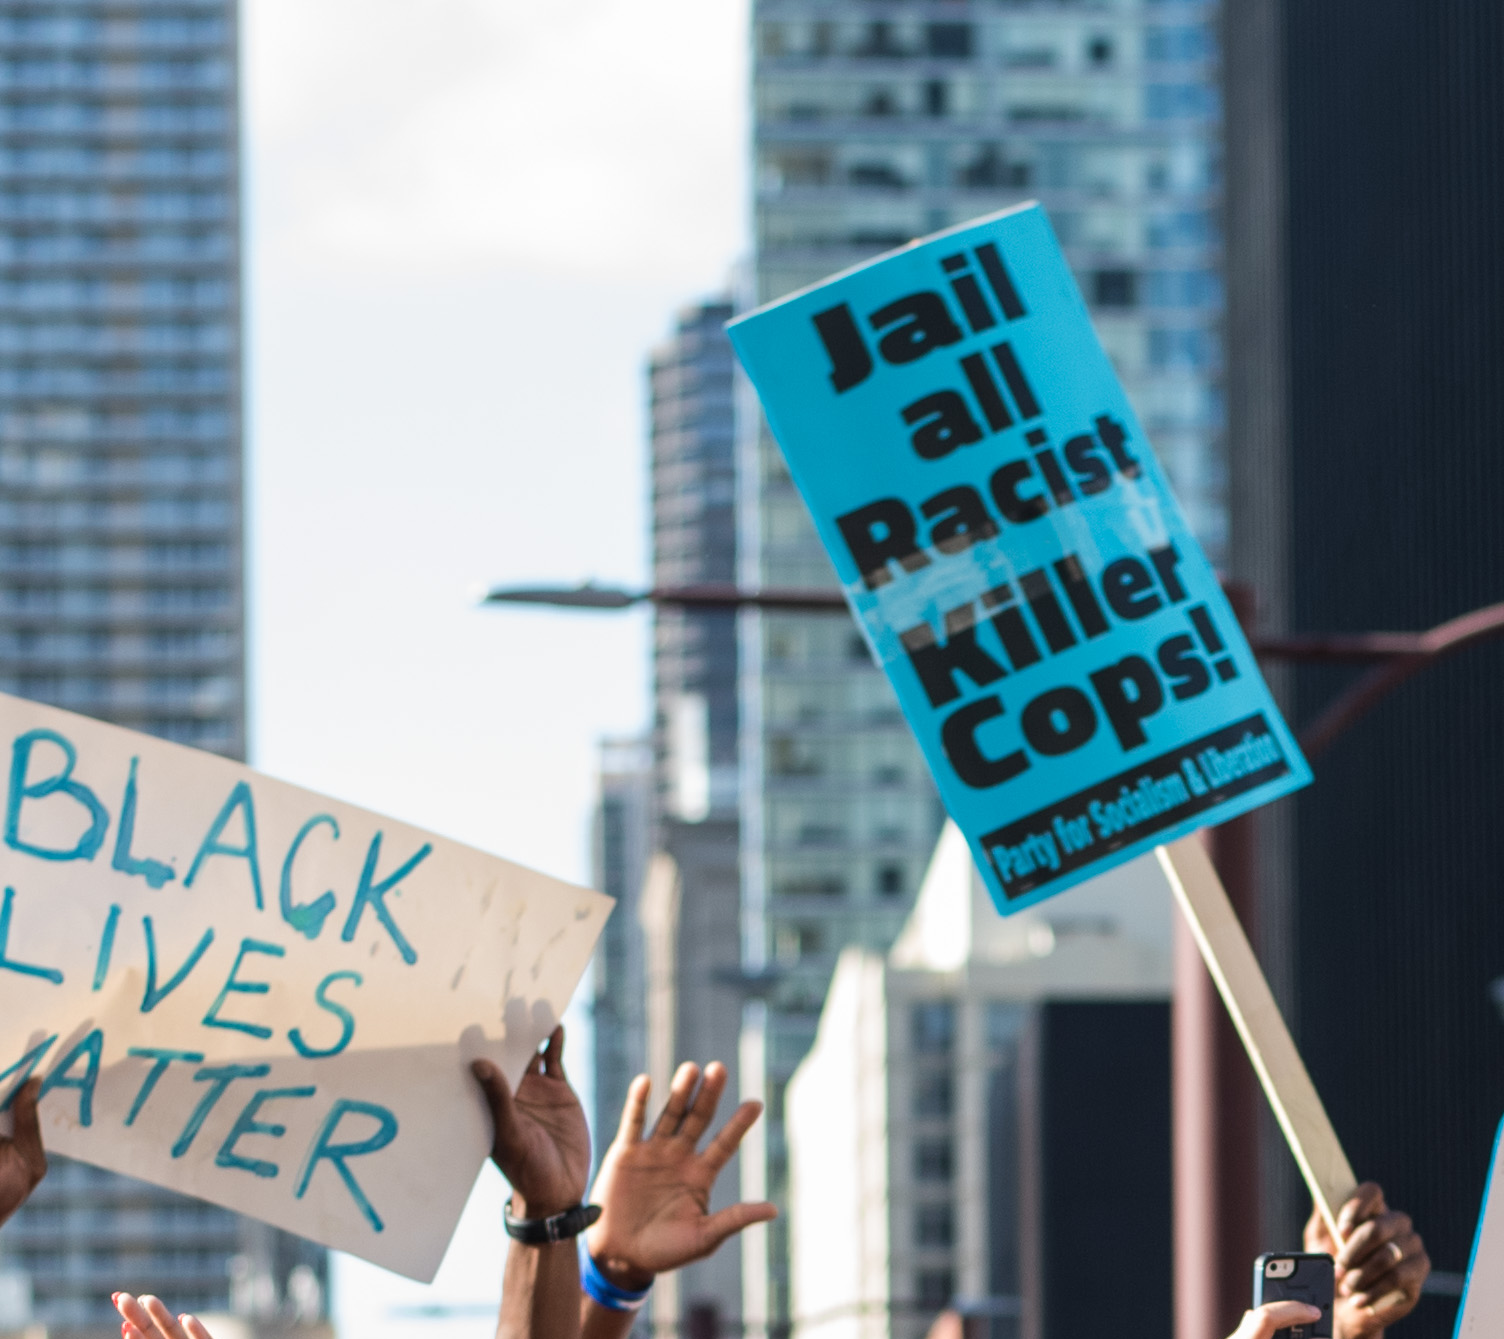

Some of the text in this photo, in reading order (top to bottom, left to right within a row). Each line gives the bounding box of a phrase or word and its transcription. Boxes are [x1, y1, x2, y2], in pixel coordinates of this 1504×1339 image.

[811, 242, 1027, 394] Jail
[901, 342, 1042, 462] all
[836, 414, 1144, 590] Racist
[898, 545, 1190, 709] Killer
[937, 605, 1241, 790] Cops!
[5, 729, 435, 966] BLACK
[992, 830, 1060, 884] Party
[1052, 815, 1095, 854] for
[1088, 772, 1190, 839] Socialism
[1181, 757, 1209, 796] &
